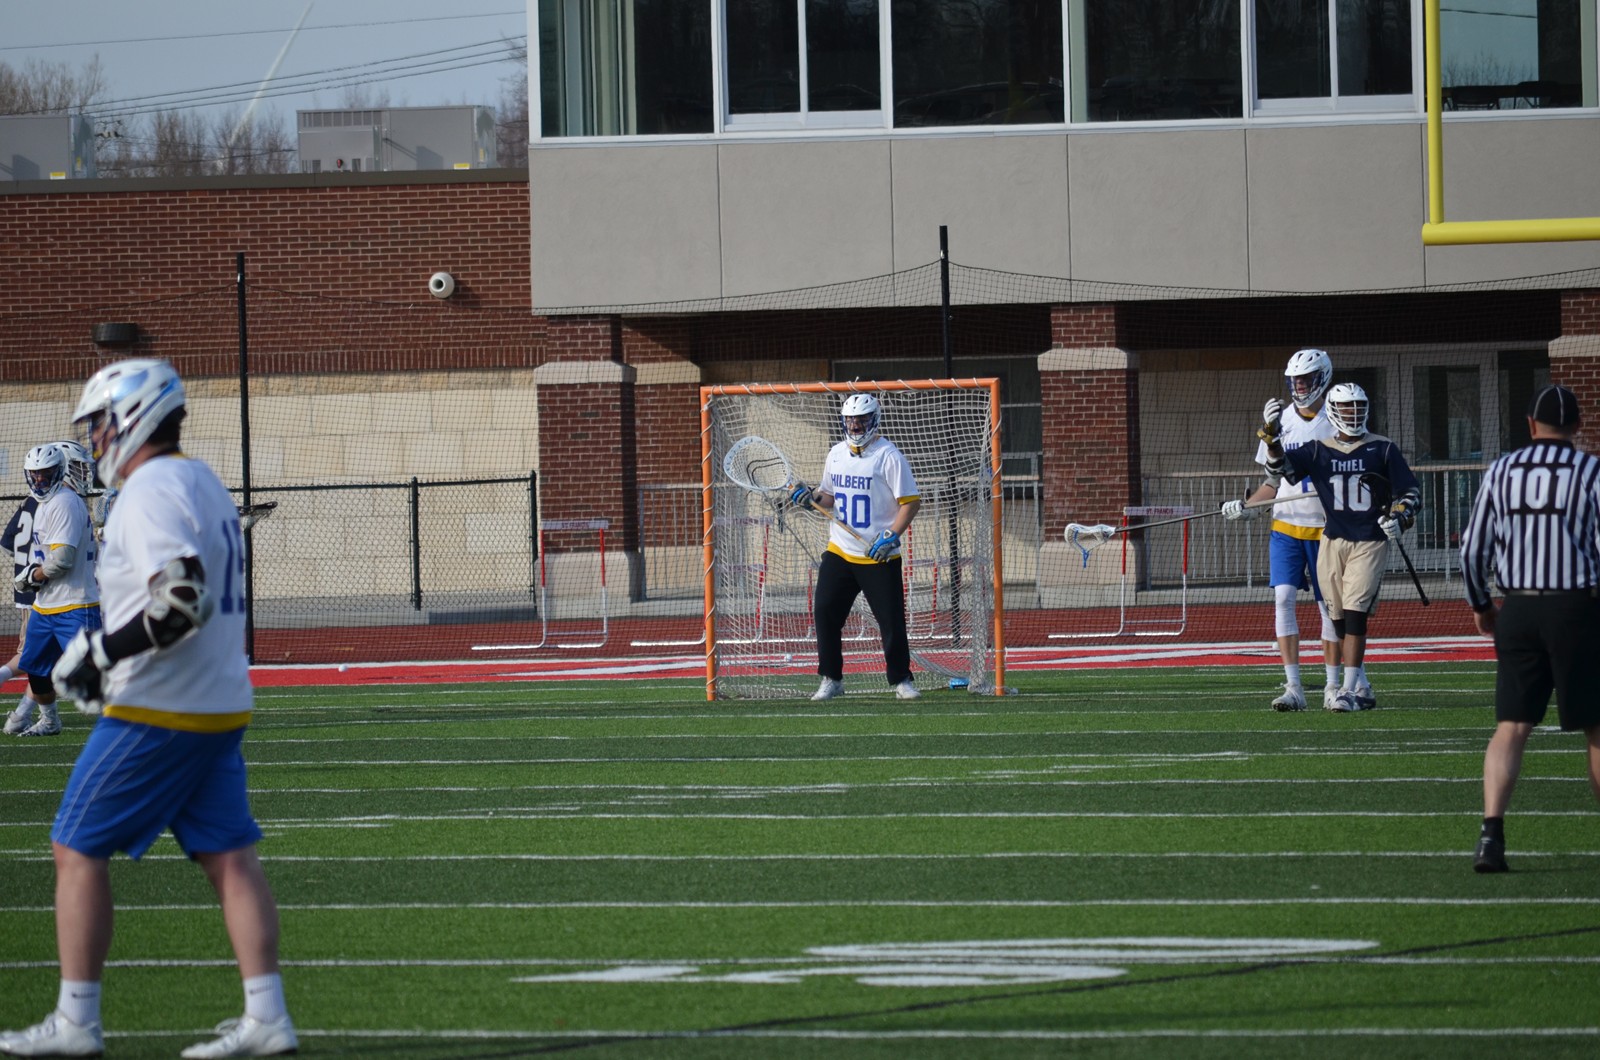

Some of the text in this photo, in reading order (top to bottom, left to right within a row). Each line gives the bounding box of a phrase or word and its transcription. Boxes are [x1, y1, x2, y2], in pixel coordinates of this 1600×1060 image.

[830, 473, 873, 490] HILBERT
[1331, 459, 1366, 472] THIEL
[1329, 474, 1372, 512] 10
[1509, 467, 1572, 510] 101
[834, 492, 871, 528] 30
